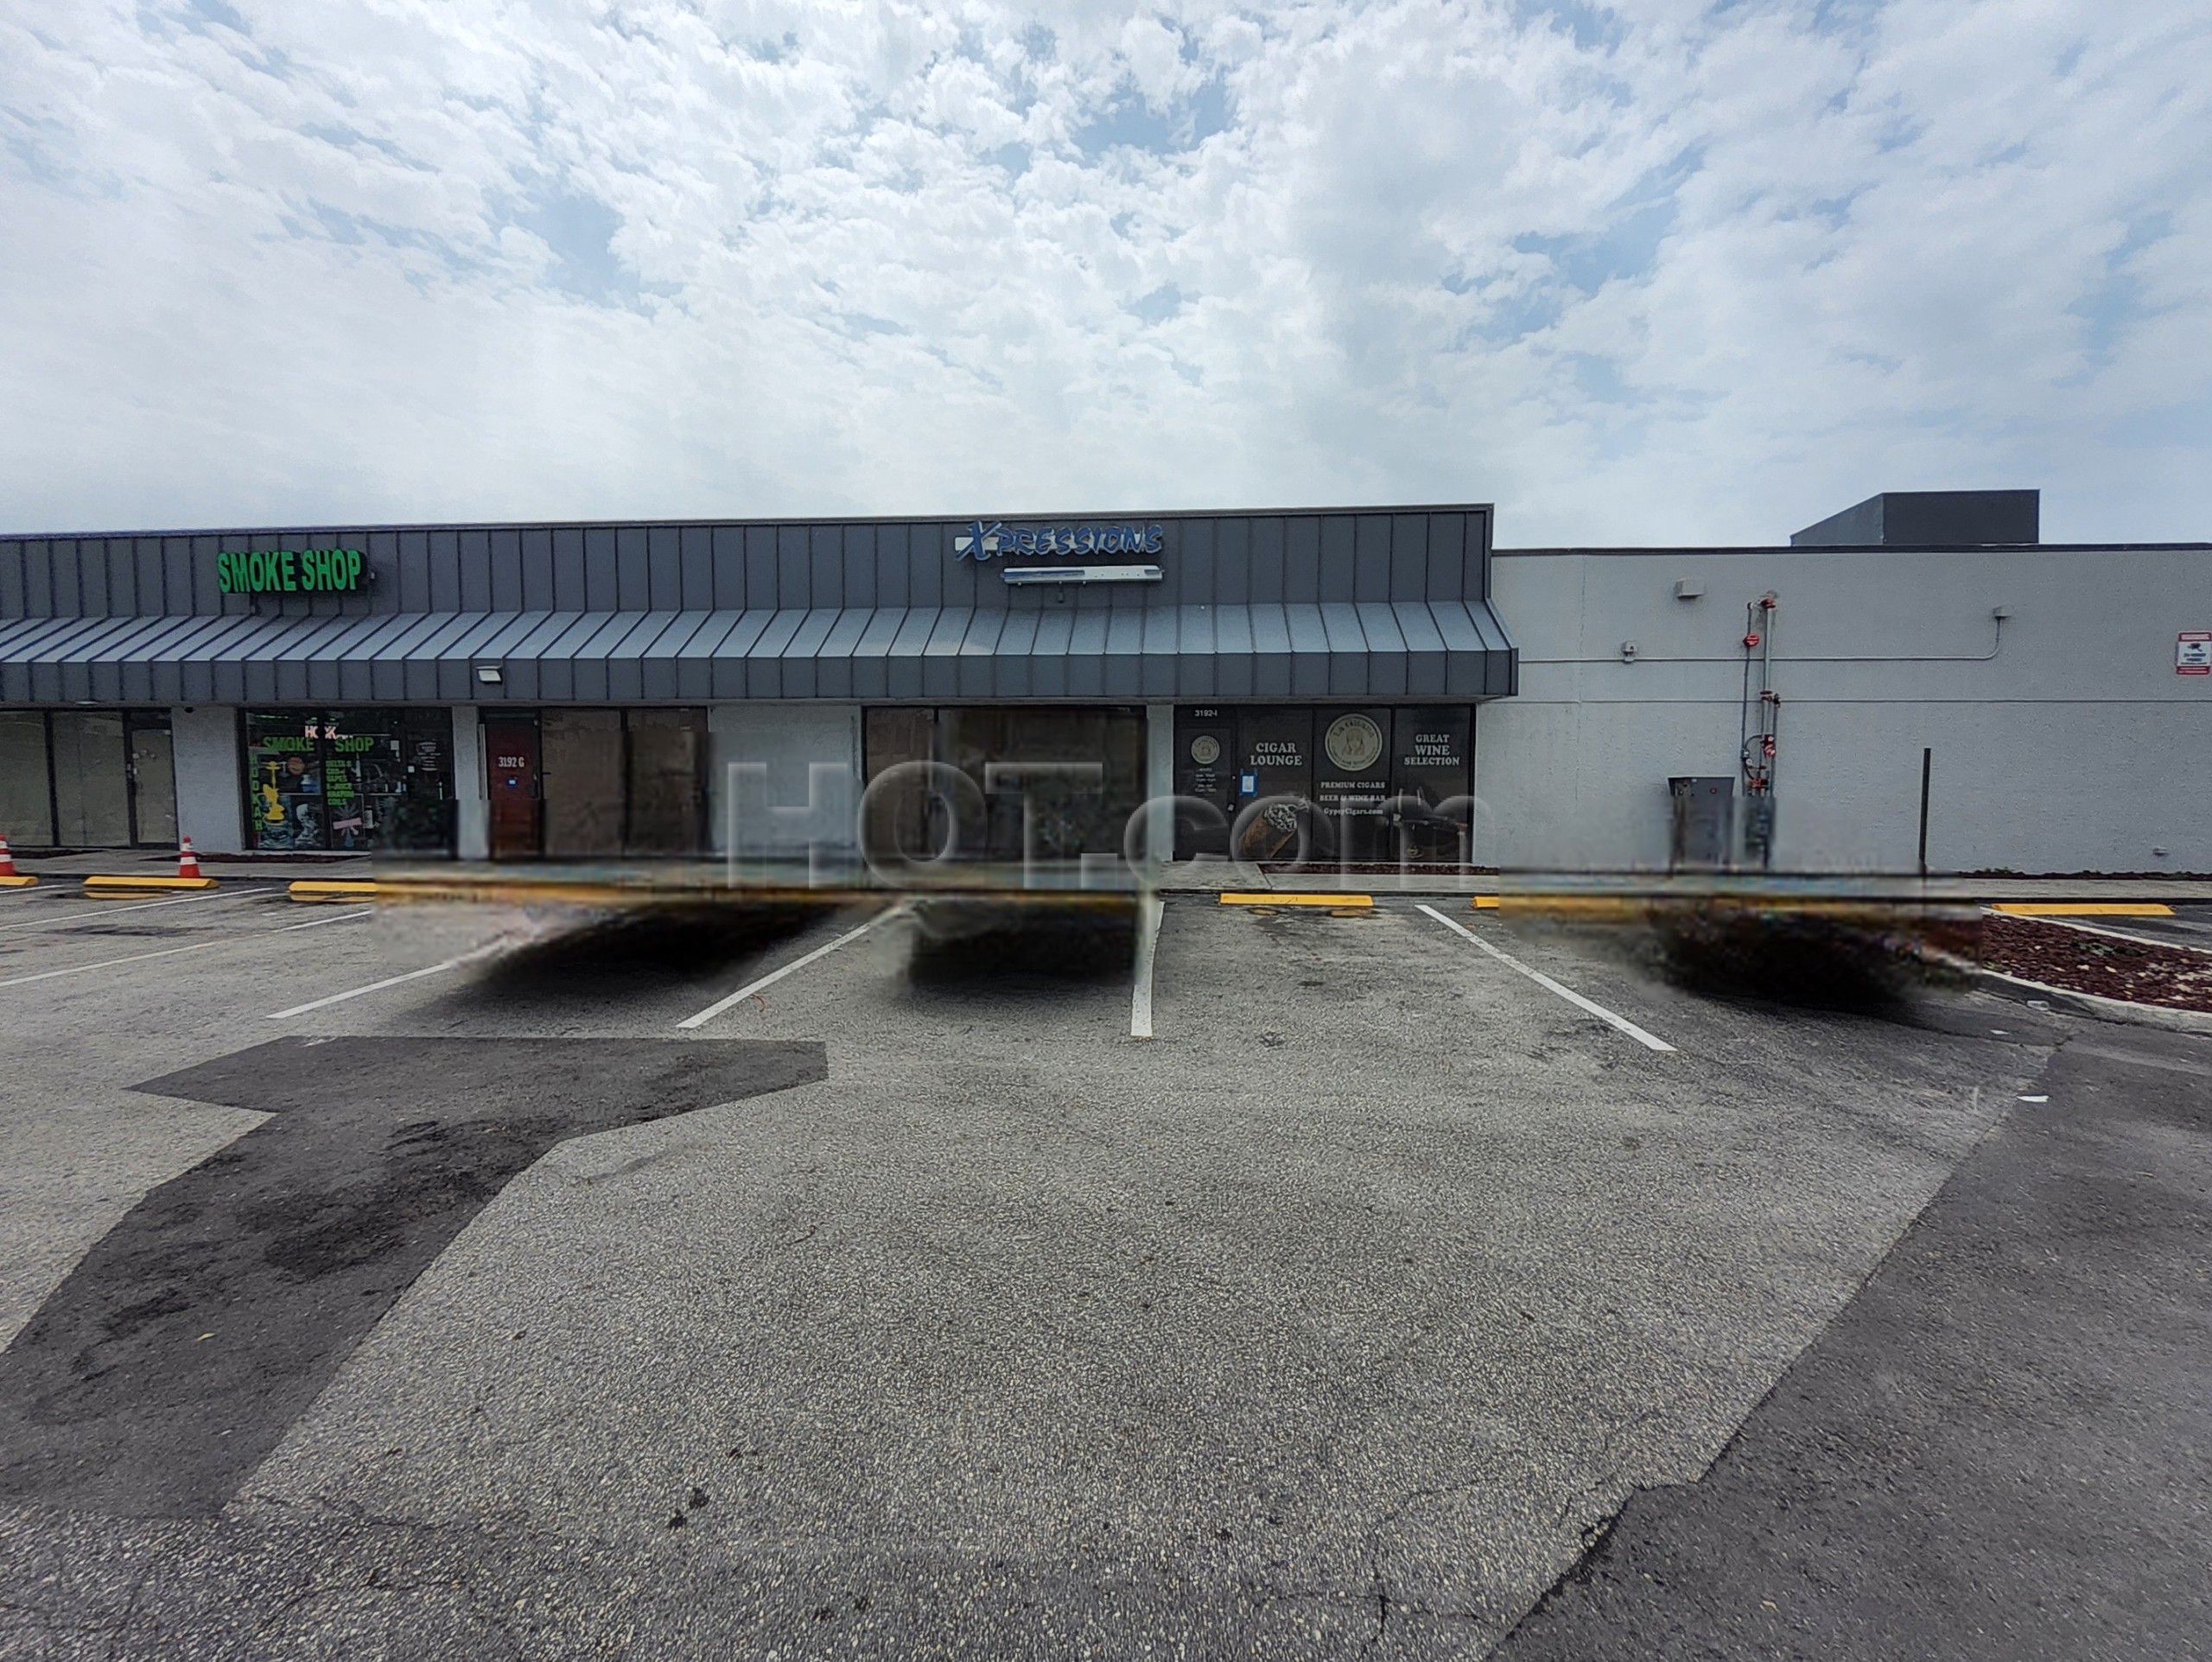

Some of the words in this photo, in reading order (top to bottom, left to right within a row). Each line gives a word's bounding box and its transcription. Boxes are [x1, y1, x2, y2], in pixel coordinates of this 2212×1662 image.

[218, 552, 297, 593] SMOKE
[302, 549, 361, 591] SHOP
[263, 737, 315, 752] SMOKE
[334, 736, 374, 752] SHOP
[1415, 734, 1450, 743] GREAT
[1255, 742, 1297, 753] CIGAR
[1414, 745, 1451, 755] WINE
[498, 756, 517, 767] 3192
[518, 756, 524, 767] G
[1249, 755, 1303, 766] LOUNGE
[1404, 756, 1460, 766] SELECTION
